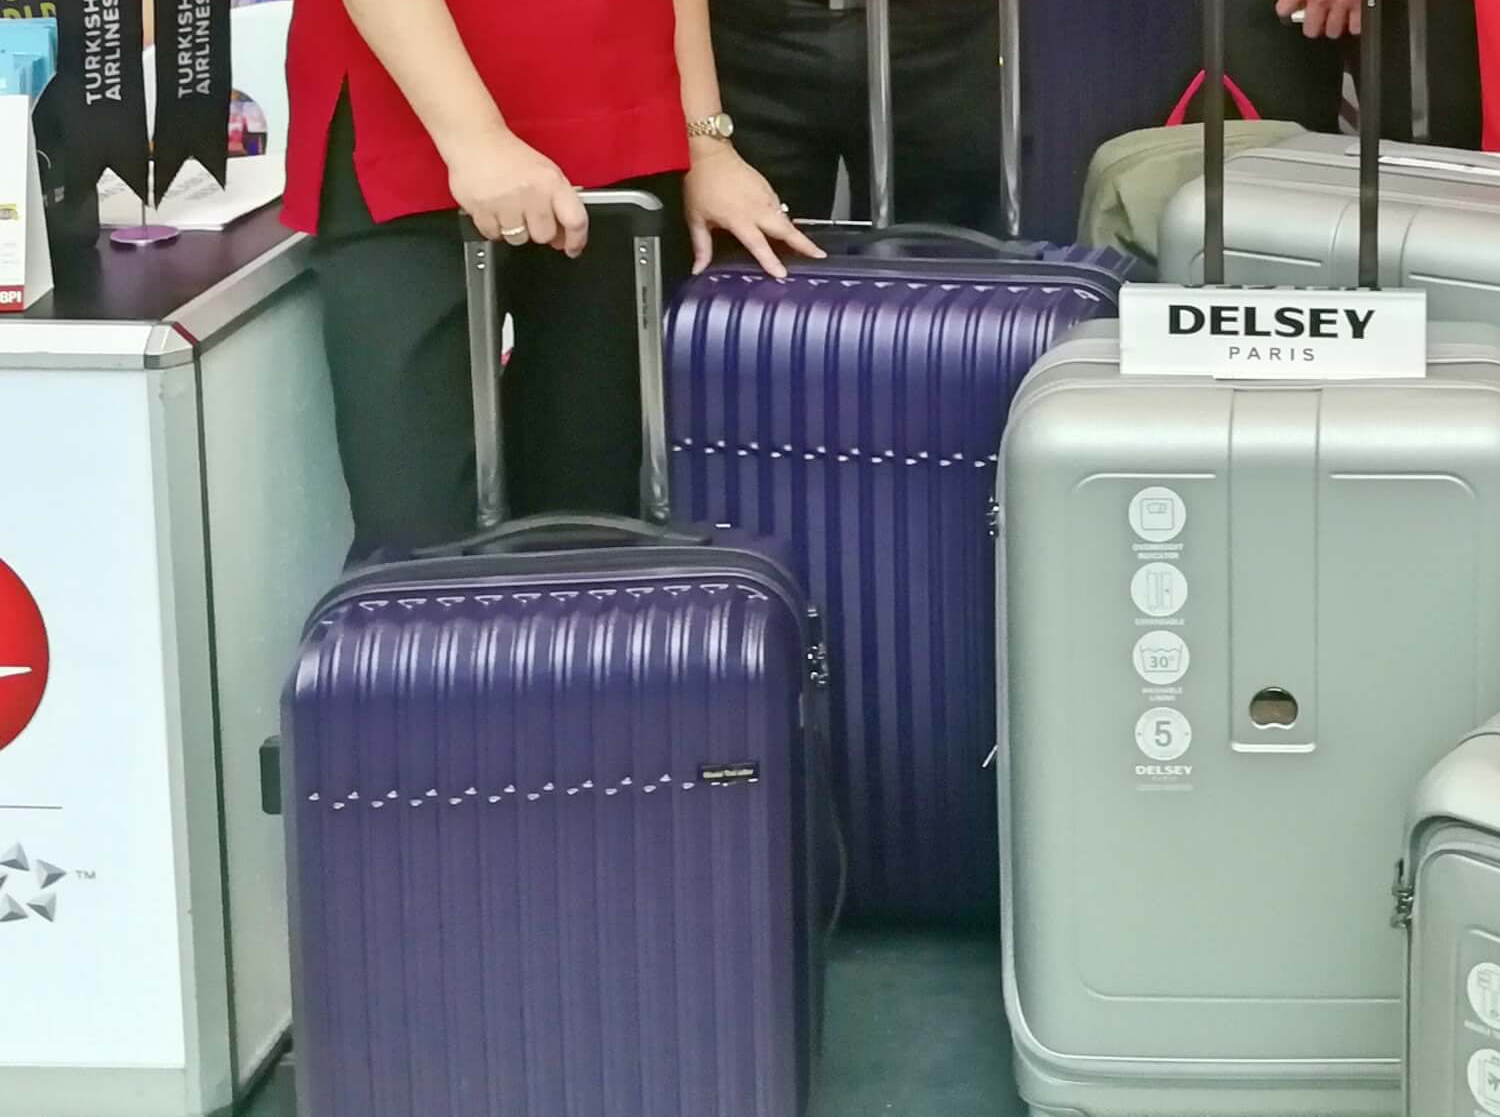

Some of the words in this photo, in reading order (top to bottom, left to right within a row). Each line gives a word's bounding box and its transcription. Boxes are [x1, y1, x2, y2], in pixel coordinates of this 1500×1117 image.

[1168, 304, 1376, 340] DELSEY
[1229, 346, 1316, 362] PARIS
[1135, 765, 1193, 776] DELSEY
